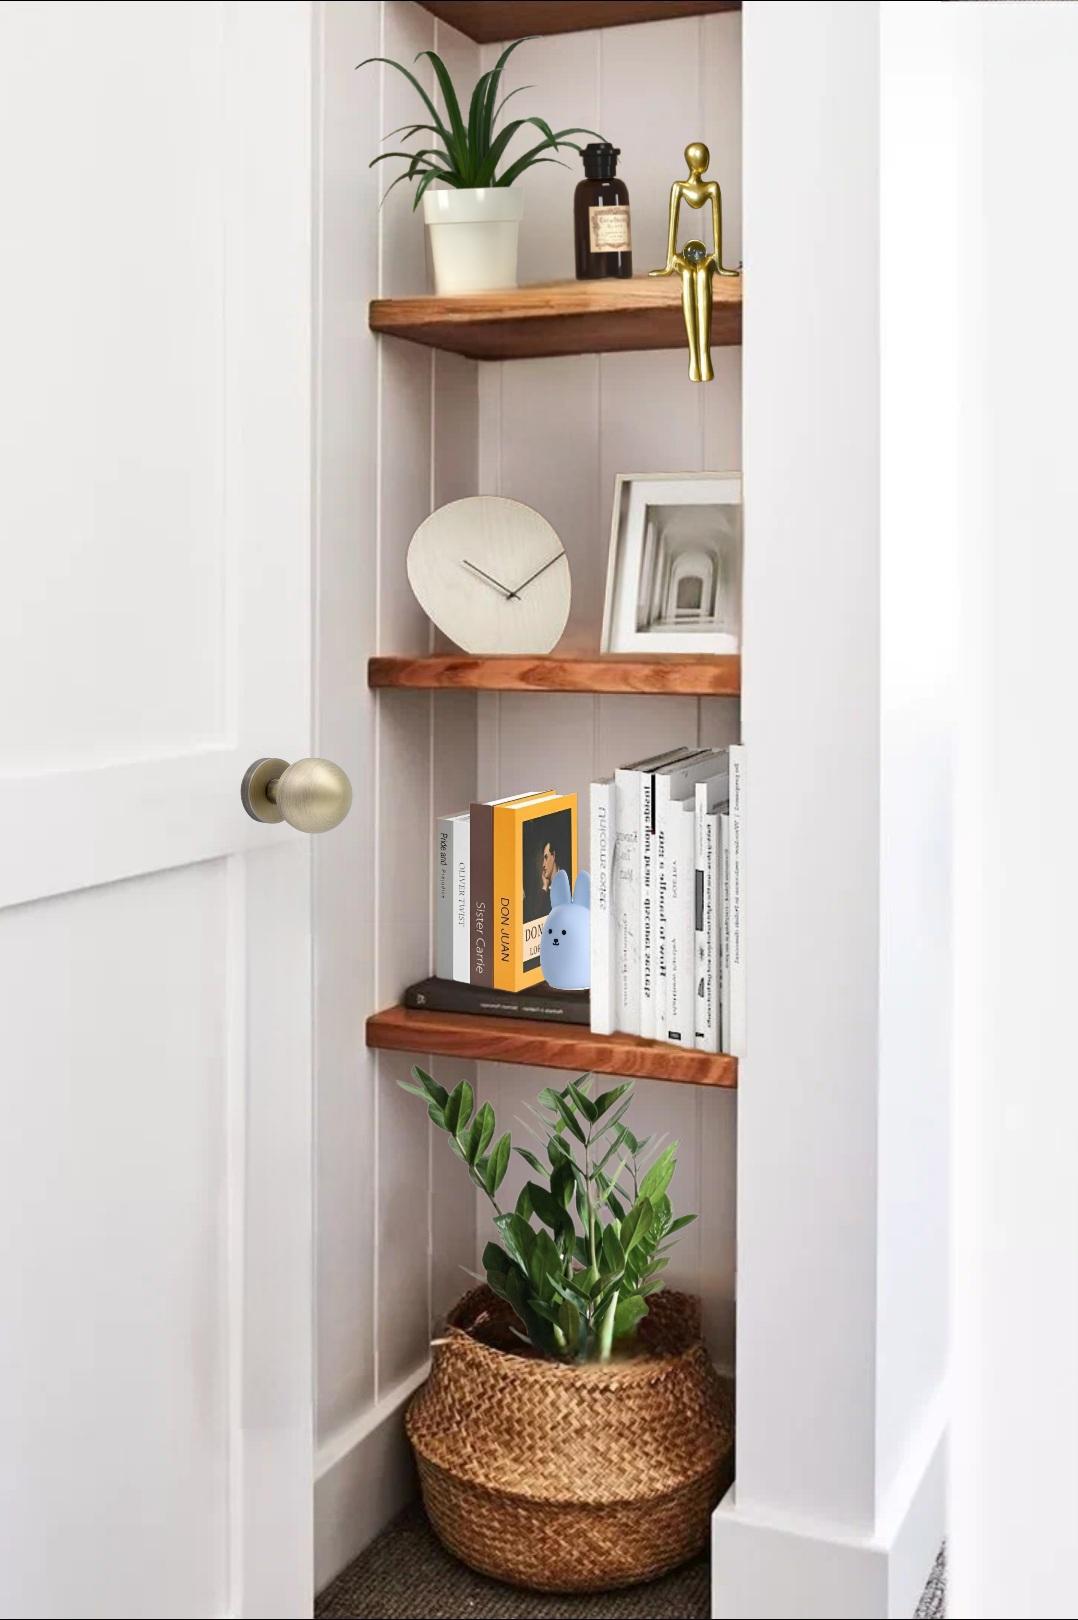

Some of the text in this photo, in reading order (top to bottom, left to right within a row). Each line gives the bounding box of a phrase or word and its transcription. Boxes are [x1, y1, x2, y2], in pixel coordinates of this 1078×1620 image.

[440, 832, 449, 851] Pride
[440, 852, 449, 866] and
[458, 862, 466, 928] OLIVER TWIST
[475, 901, 486, 974] Sister Carrie
[500, 897, 510, 963] DON JUAN
[525, 923, 544, 942] DON
